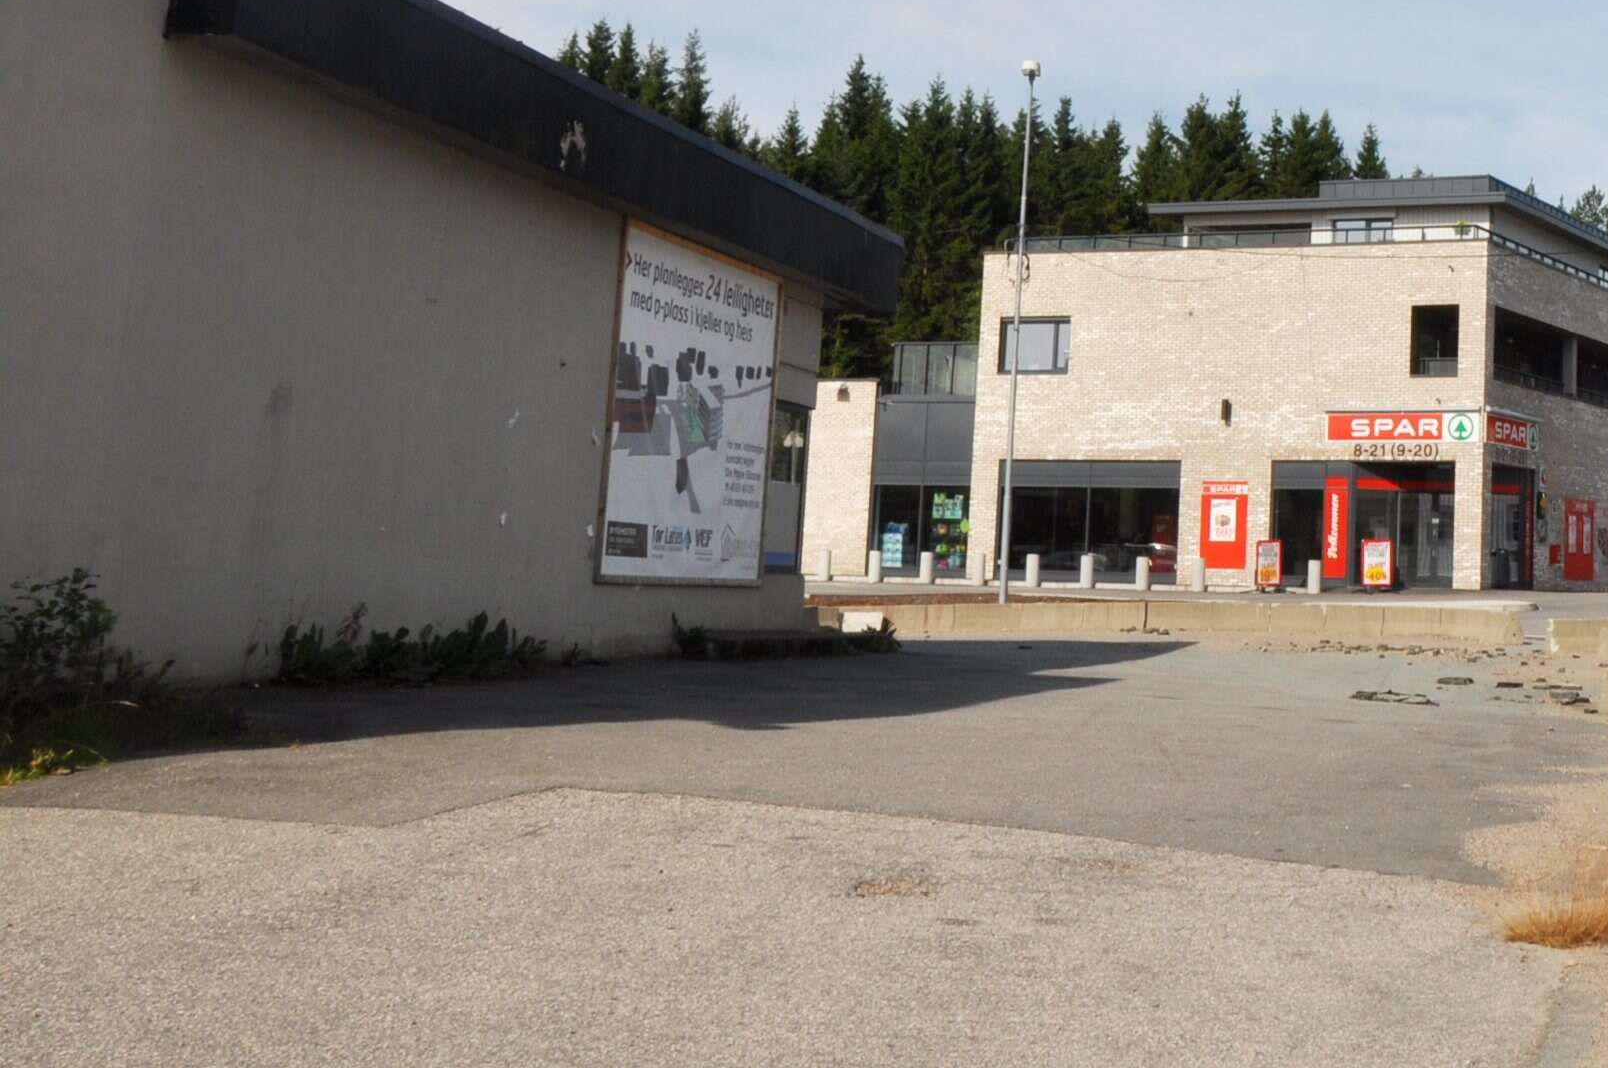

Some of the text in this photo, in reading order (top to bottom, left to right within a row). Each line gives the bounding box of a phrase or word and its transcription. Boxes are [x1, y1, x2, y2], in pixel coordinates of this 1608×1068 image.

[633, 253, 652, 277] Her
[653, 261, 705, 298] planlegges
[705, 274, 722, 303] 24
[630, 290, 652, 312] med
[654, 297, 689, 323] p-plass
[695, 307, 723, 332] kjeller
[724, 319, 736, 342] og
[736, 318, 753, 342] heis
[1351, 418, 1439, 437] SPAR
[1494, 420, 1526, 442] SPAR
[1353, 443, 1439, 460] 8-21 (9-20)
